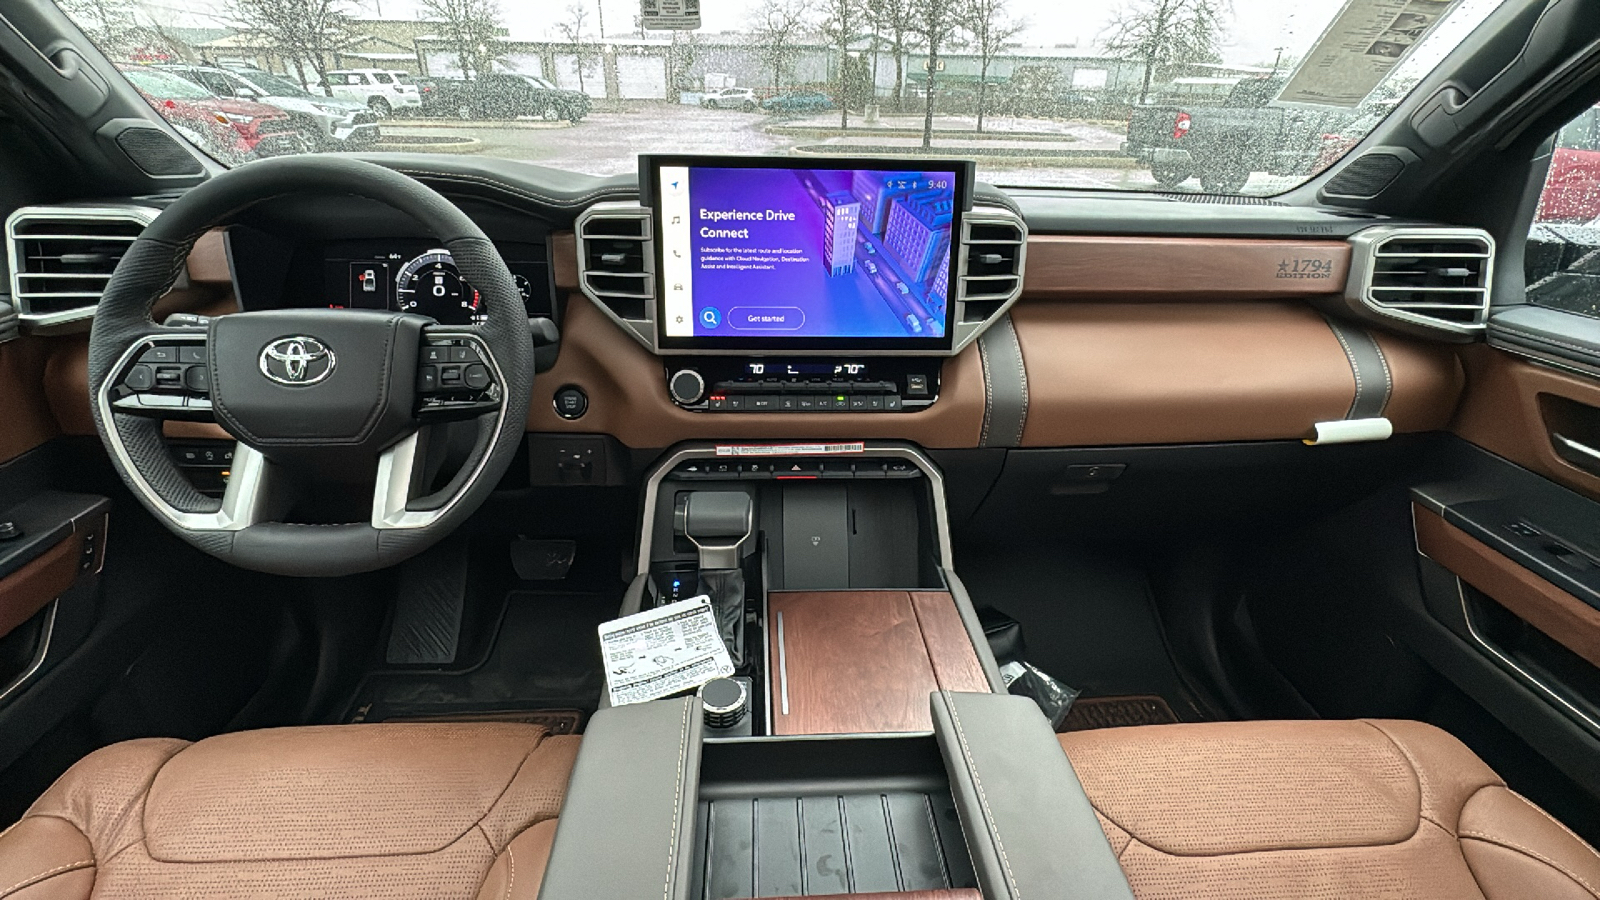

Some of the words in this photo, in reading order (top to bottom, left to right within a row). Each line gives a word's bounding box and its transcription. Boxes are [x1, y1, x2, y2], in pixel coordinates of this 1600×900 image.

[928, 179, 948, 189] 9:40
[699, 208, 764, 222] Experience
[765, 209, 796, 221] Drive
[699, 227, 749, 239] Connect
[700, 255, 724, 263] guidance
[1291, 259, 1333, 273] 1794
[433, 285, 445, 296] 0
[747, 313, 760, 323] Get
[761, 313, 785, 323] started
[749, 364, 764, 374] 70
[843, 364, 858, 374] 70
